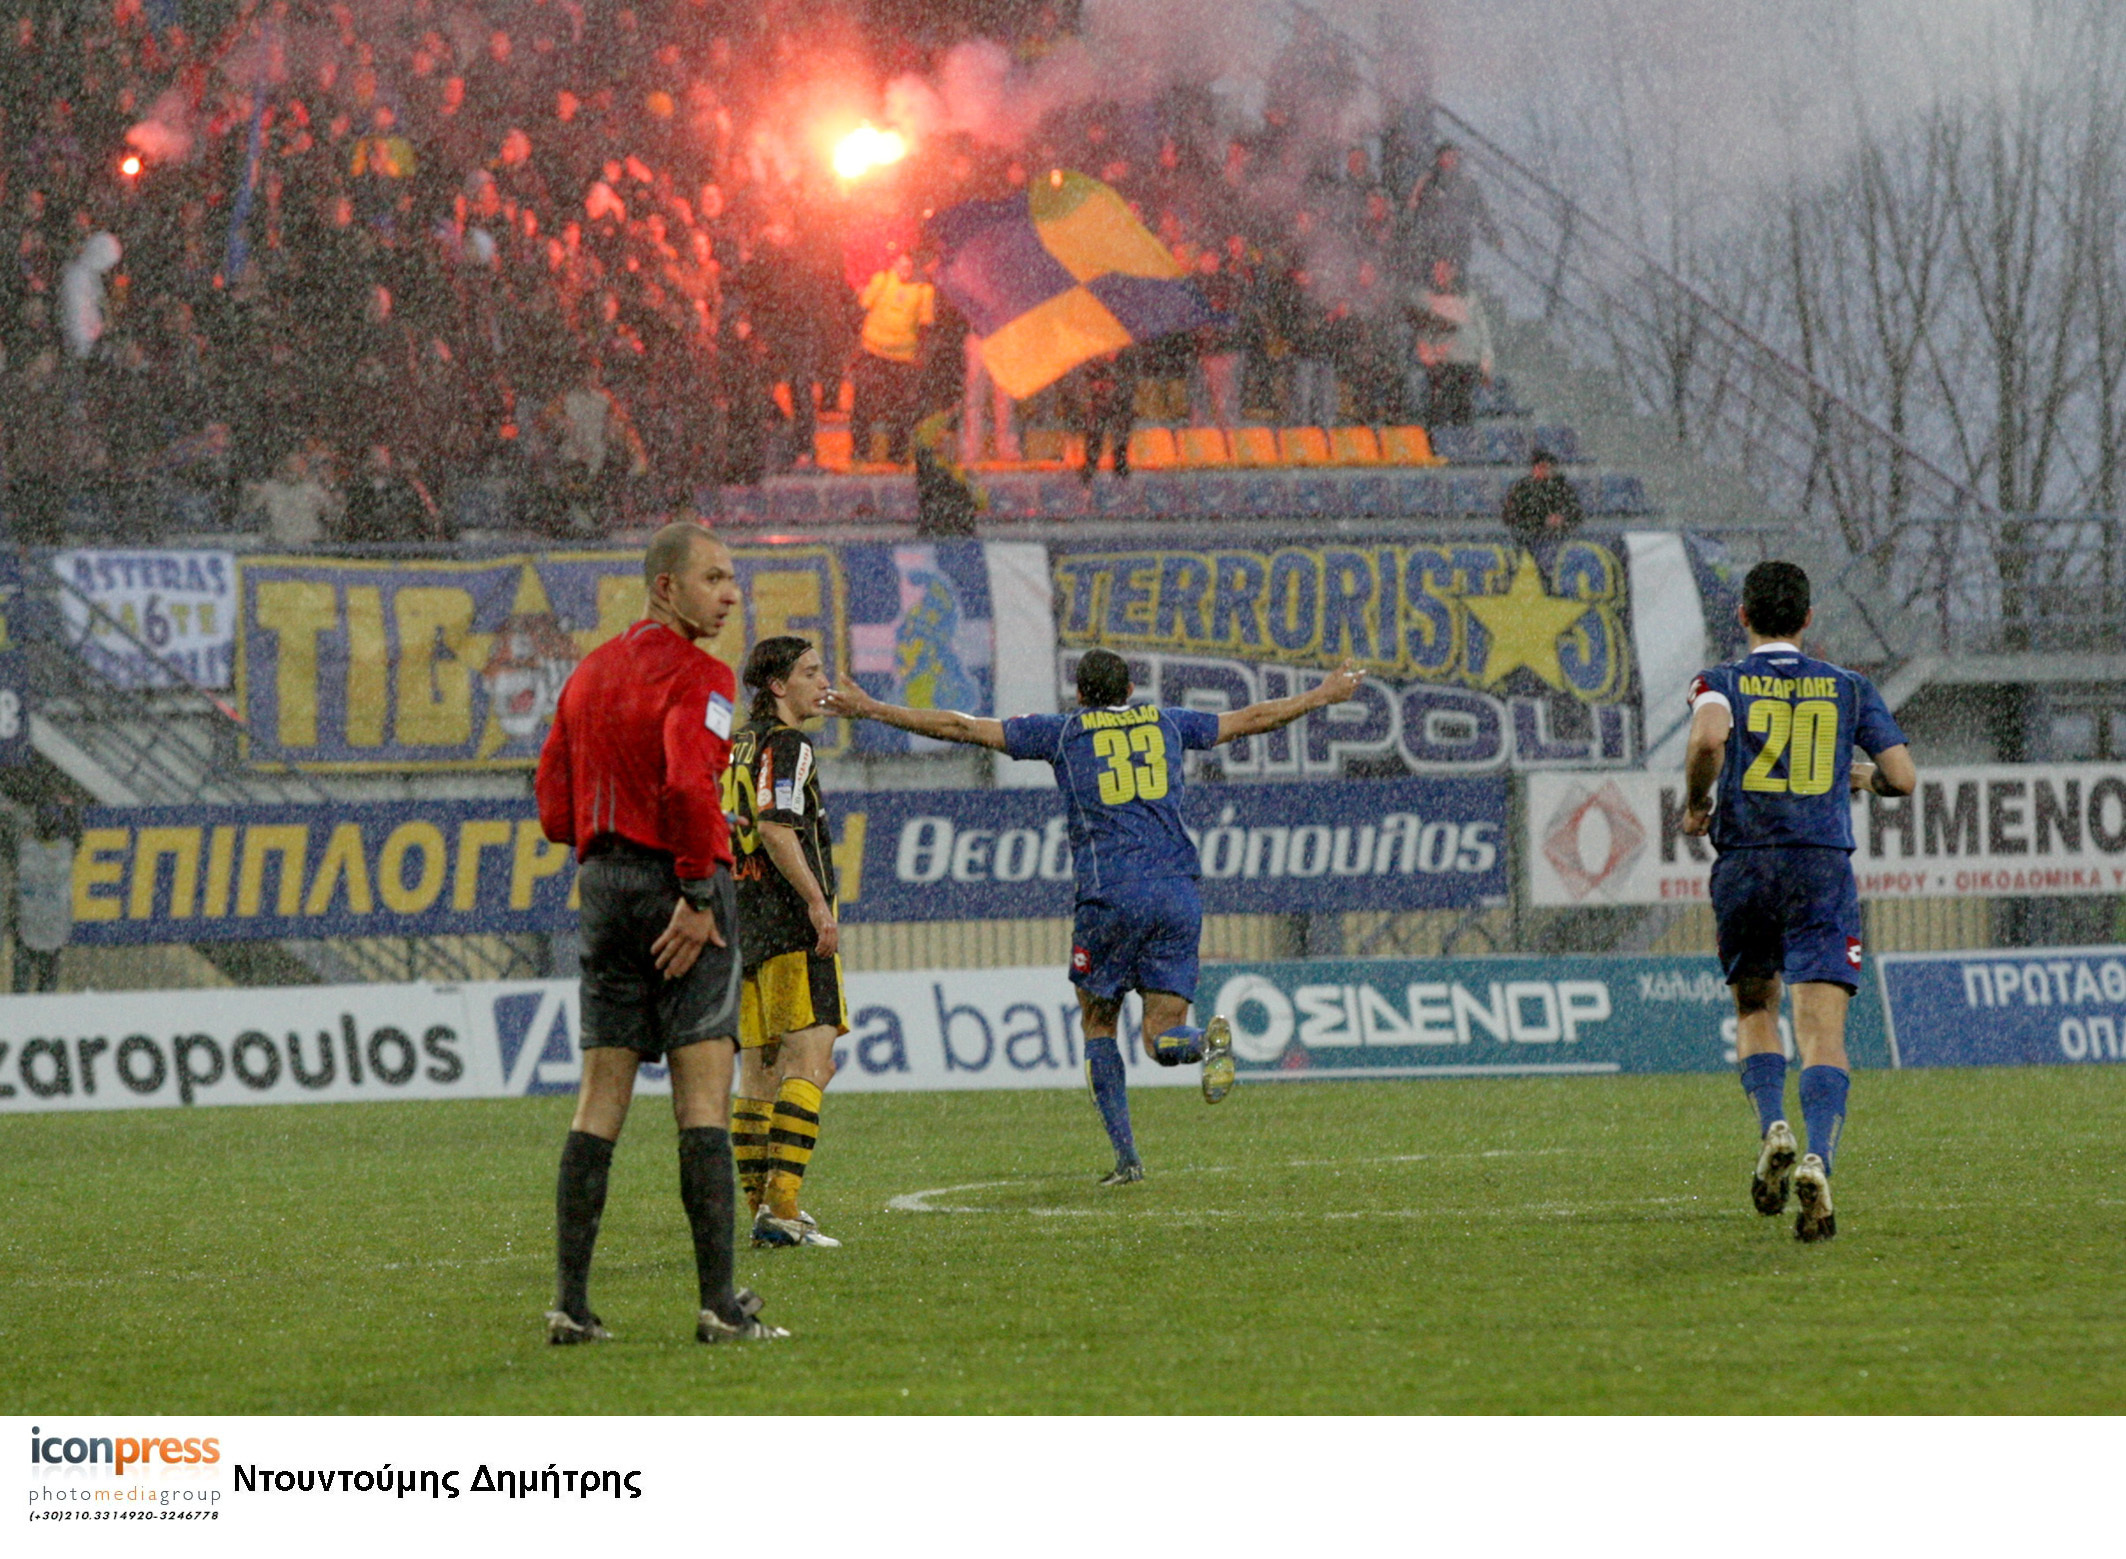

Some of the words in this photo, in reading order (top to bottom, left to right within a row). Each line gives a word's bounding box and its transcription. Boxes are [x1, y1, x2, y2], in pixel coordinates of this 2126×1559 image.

[1093, 724, 1168, 805] 33
[1742, 699, 1838, 795] 20
[2060, 1015, 2126, 1059] ΟΠ
